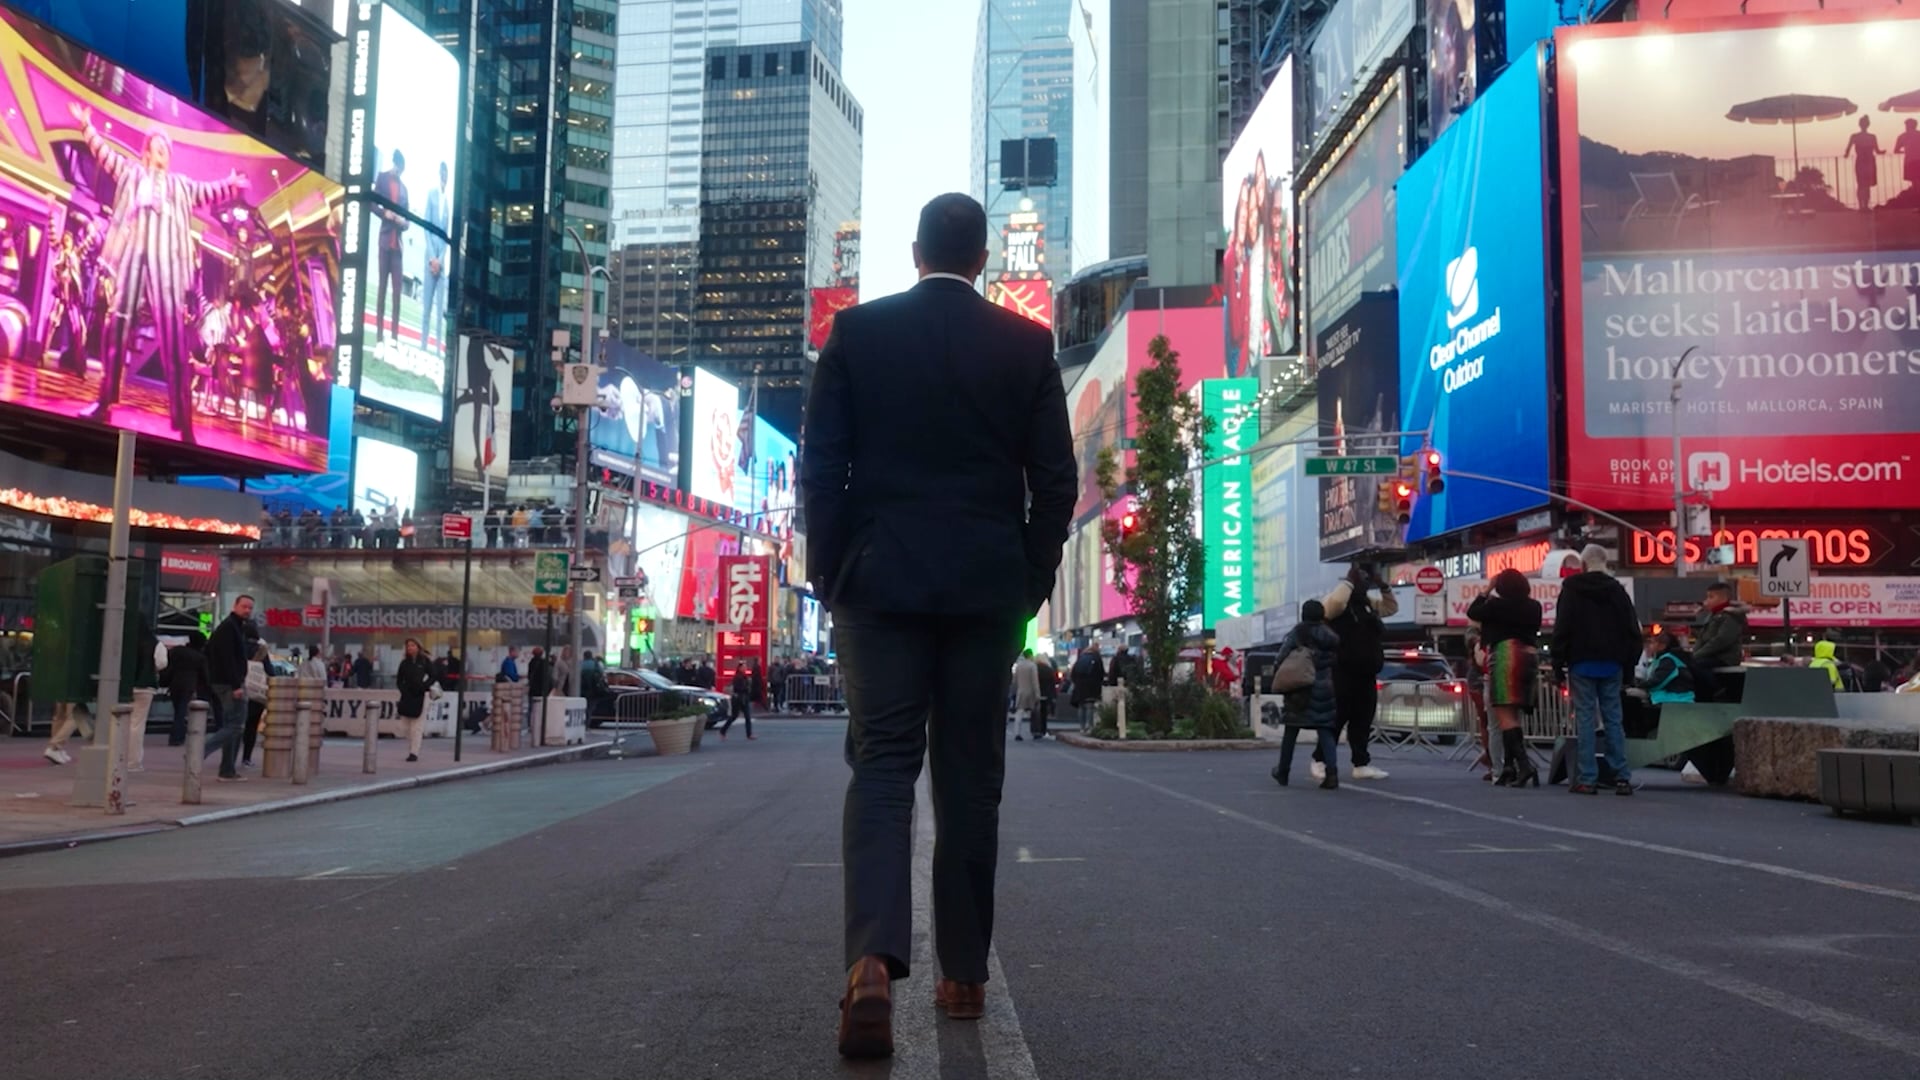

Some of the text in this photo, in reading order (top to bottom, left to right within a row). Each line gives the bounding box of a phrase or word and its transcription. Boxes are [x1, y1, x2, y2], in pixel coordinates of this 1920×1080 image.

[1008, 232, 1039, 246] HAPPY
[1007, 245, 1039, 272] FALL
[1603, 258, 1819, 296] Mallorcan
[1606, 293, 1920, 338] seeks laid-back
[1430, 306, 1500, 371] Clear Channel
[1444, 355, 1485, 393] Outdoor
[1606, 345, 1920, 389] honeymooners
[1609, 398, 1883, 414] MARISTE HOTEL, MALLORCA, SPAIN
[1326, 459, 1376, 472] W 47 St
[1610, 459, 1651, 471] BOOK
[1740, 457, 1901, 483] Hotels.com
[1611, 472, 1641, 484] THE
[649, 481, 682, 505] 540
[1222, 388, 1242, 618] AMERICAN EAGLE
[1714, 529, 1871, 564] CANOS
[168, 558, 213, 572] BROADWAY
[1463, 551, 1481, 574] FIN
[730, 561, 762, 625] tkts
[1768, 581, 1801, 592] ONLY
[1810, 583, 1871, 598] AMINOS
[1788, 602, 1823, 614] ARE
[1829, 602, 1882, 614] OPEN
